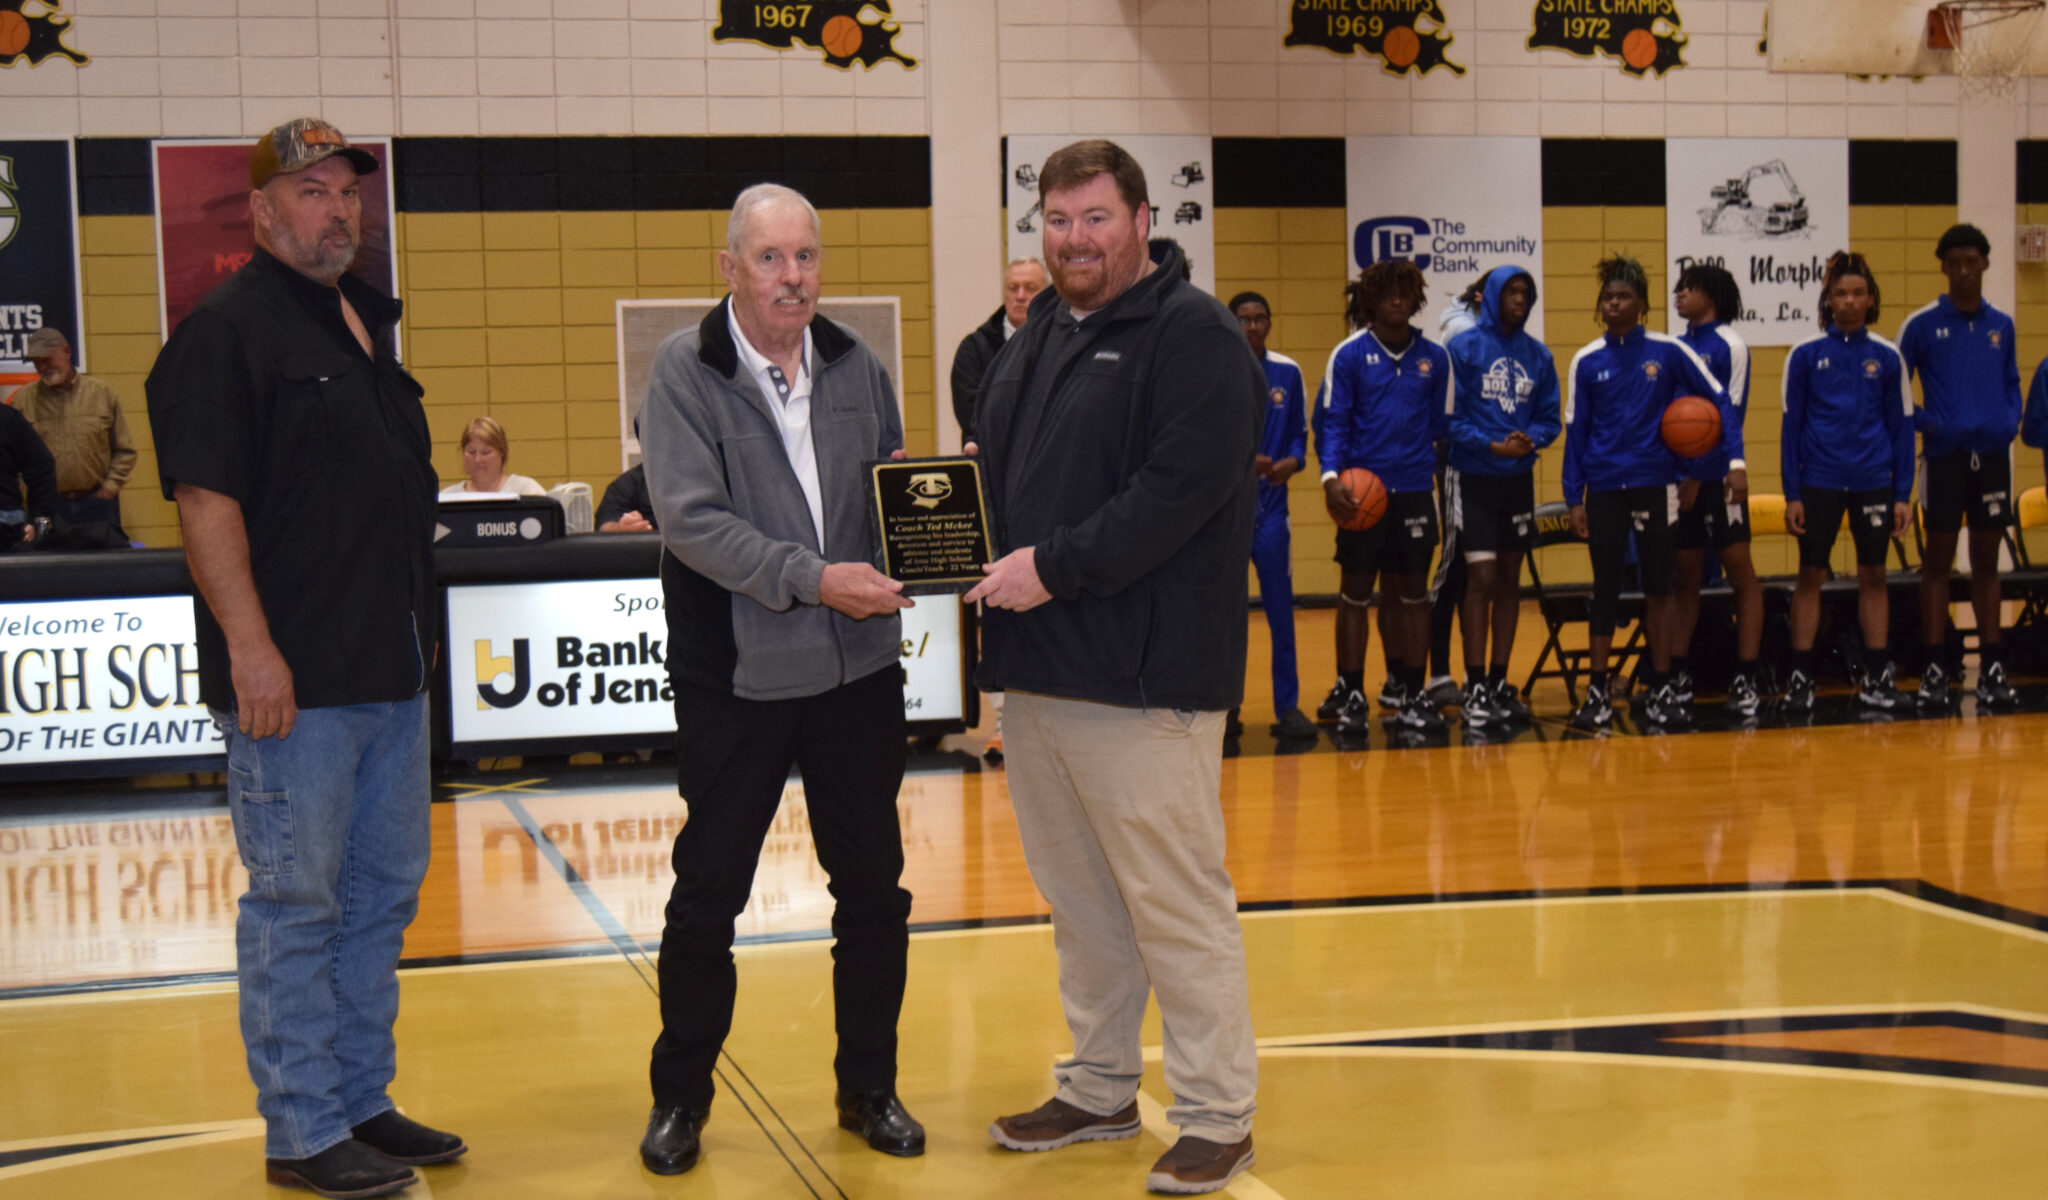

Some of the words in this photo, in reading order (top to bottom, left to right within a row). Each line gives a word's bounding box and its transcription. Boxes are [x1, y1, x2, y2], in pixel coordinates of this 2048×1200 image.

[755, 5, 812, 28] 1967
[1542, 0, 1595, 13] STATE
[1601, 0, 1672, 14] CHAMPS
[1328, 14, 1383, 37] 1969
[1563, 17, 1611, 39] 1972
[1432, 218, 1465, 235] The
[1432, 235, 1536, 257] Community
[1433, 255, 1478, 273] Bank
[477, 522, 517, 537] BONUS
[895, 523, 923, 533] Coach
[926, 522, 942, 531] Ted
[613, 593, 665, 616] Spo
[114, 612, 142, 632] To
[537, 672, 581, 707] of
[41, 726, 96, 750] THE
